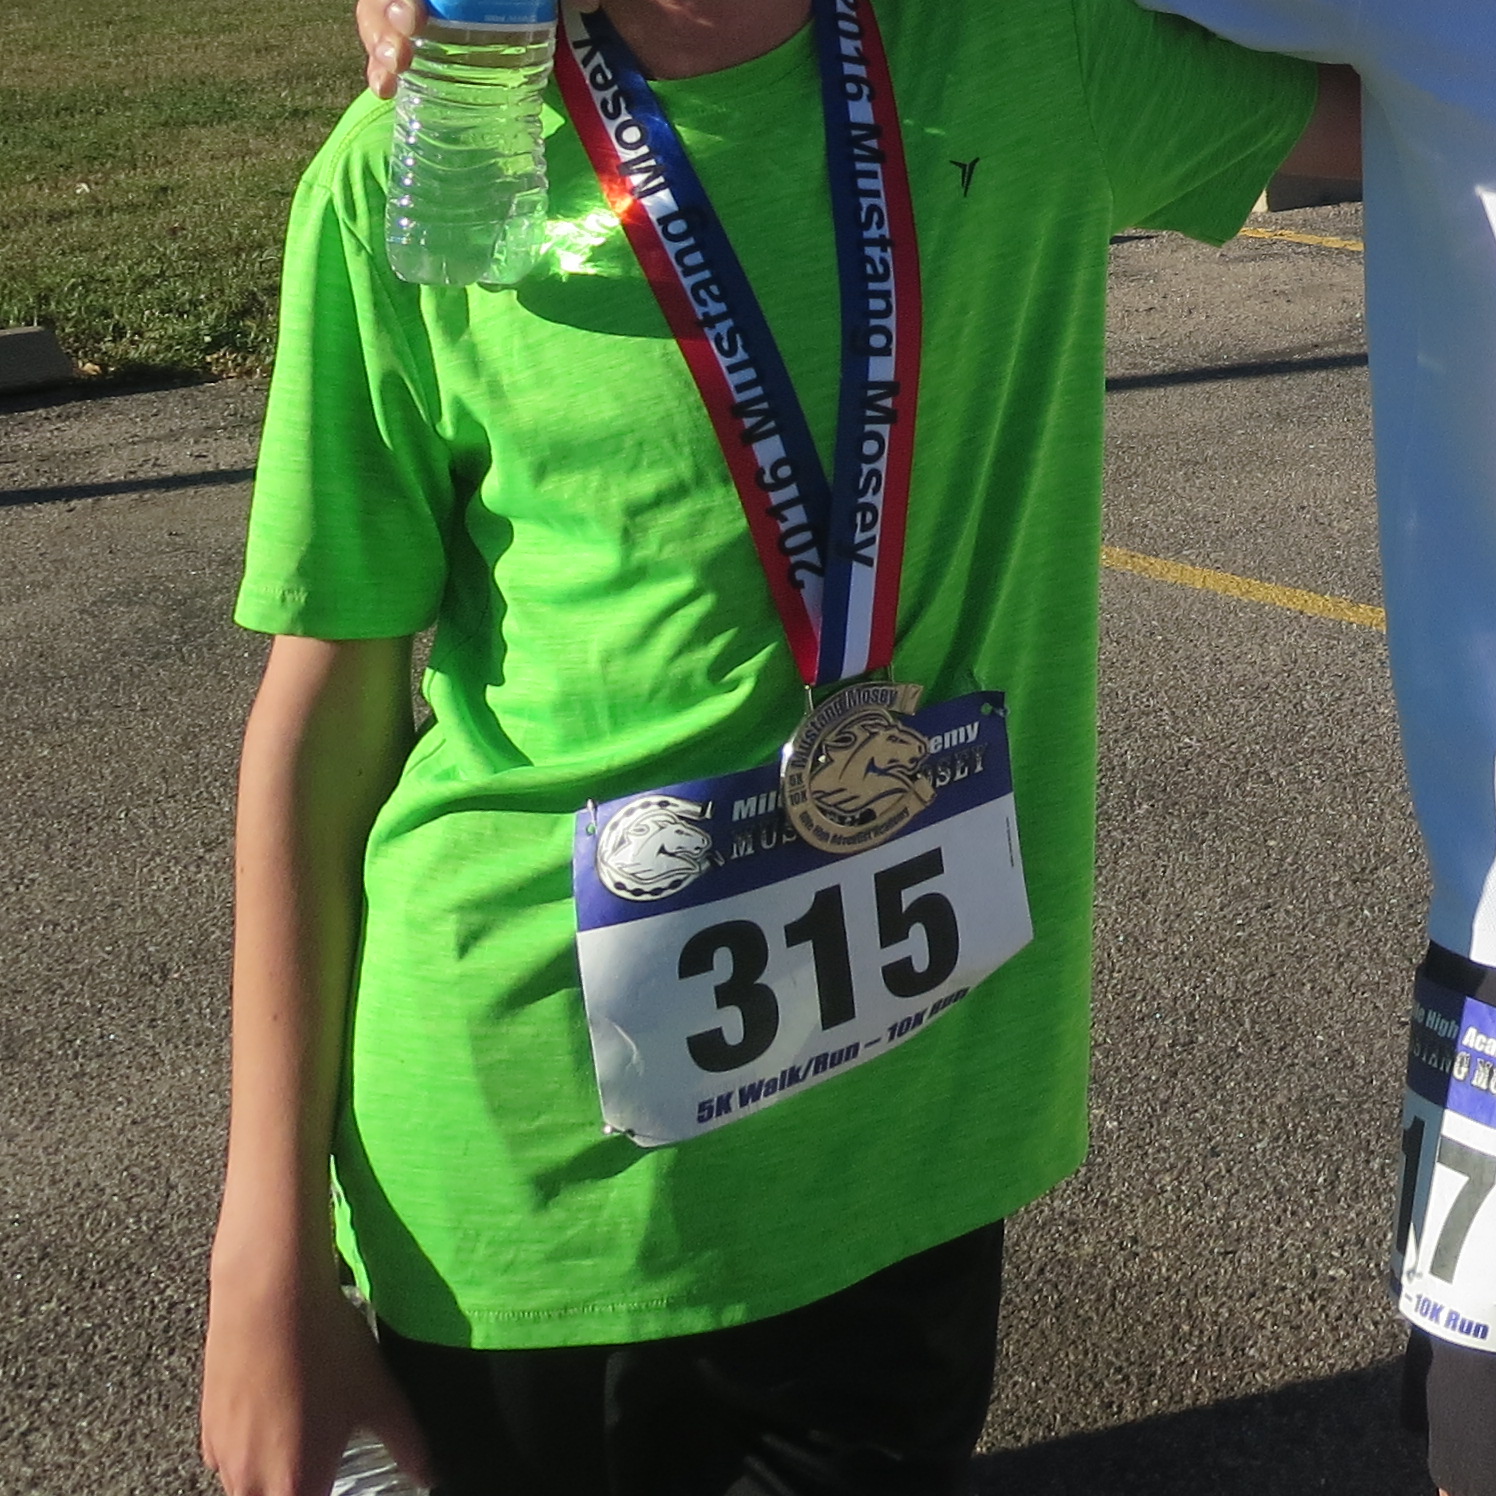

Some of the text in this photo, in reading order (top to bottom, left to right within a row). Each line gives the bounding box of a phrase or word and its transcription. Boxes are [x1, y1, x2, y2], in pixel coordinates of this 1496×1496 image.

[845, 122, 898, 357] Mustang
[572, 37, 828, 592] 2016 Mustang Mosey
[839, 381, 901, 568] Mosey
[847, 687, 899, 709] Mosey
[731, 790, 782, 822] Mil
[677, 846, 961, 1076] 315
[696, 1091, 735, 1124] 5K
[739, 1041, 861, 1109] Walk/Run
[887, 1012, 928, 1042] 10K
[1425, 1008, 1460, 1040] High
[1414, 1293, 1446, 1324] 10K
[1443, 1309, 1490, 1341] Run
